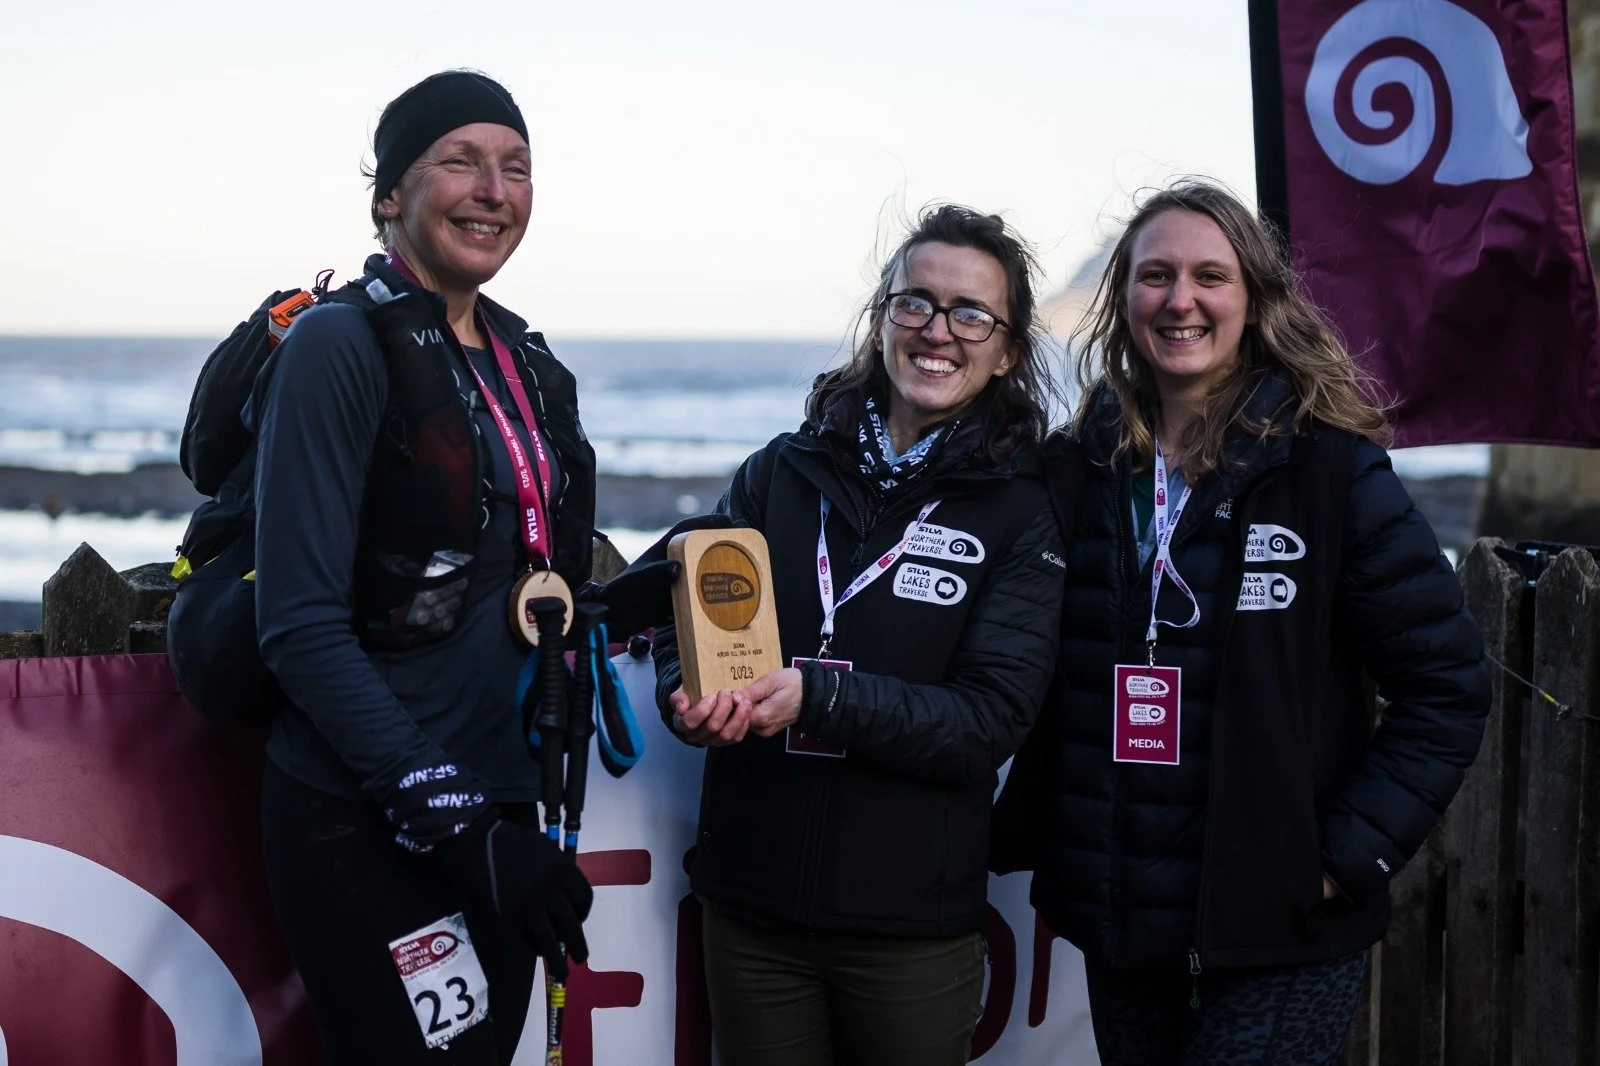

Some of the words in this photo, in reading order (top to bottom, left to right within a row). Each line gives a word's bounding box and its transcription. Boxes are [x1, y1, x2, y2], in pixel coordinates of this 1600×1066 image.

[869, 413, 885, 450] SILVA
[493, 404, 513, 437] NORTHERN
[510, 438, 525, 467] TRAVERSE
[520, 468, 530, 488] 2023
[1215, 510, 1232, 519] FAC
[526, 507, 539, 543] SILVA
[918, 526, 943, 536] SILVA
[910, 534, 947, 547] NORTHERN
[1247, 538, 1265, 547] HERN
[906, 542, 943, 555] TRAVERSE
[1247, 549, 1265, 557] ERSE
[906, 566, 931, 576] SILVA
[901, 574, 931, 589] LAKES
[898, 586, 928, 598] TRAVERSE
[1241, 585, 1265, 597] AKES
[1239, 598, 1266, 606] RAVERSE
[730, 666, 754, 680] 2023
[1129, 738, 1165, 749] MEDIA
[400, 956, 432, 974] TRAERSE
[414, 976, 475, 1035] 23
[549, 1008, 559, 1045] mond
